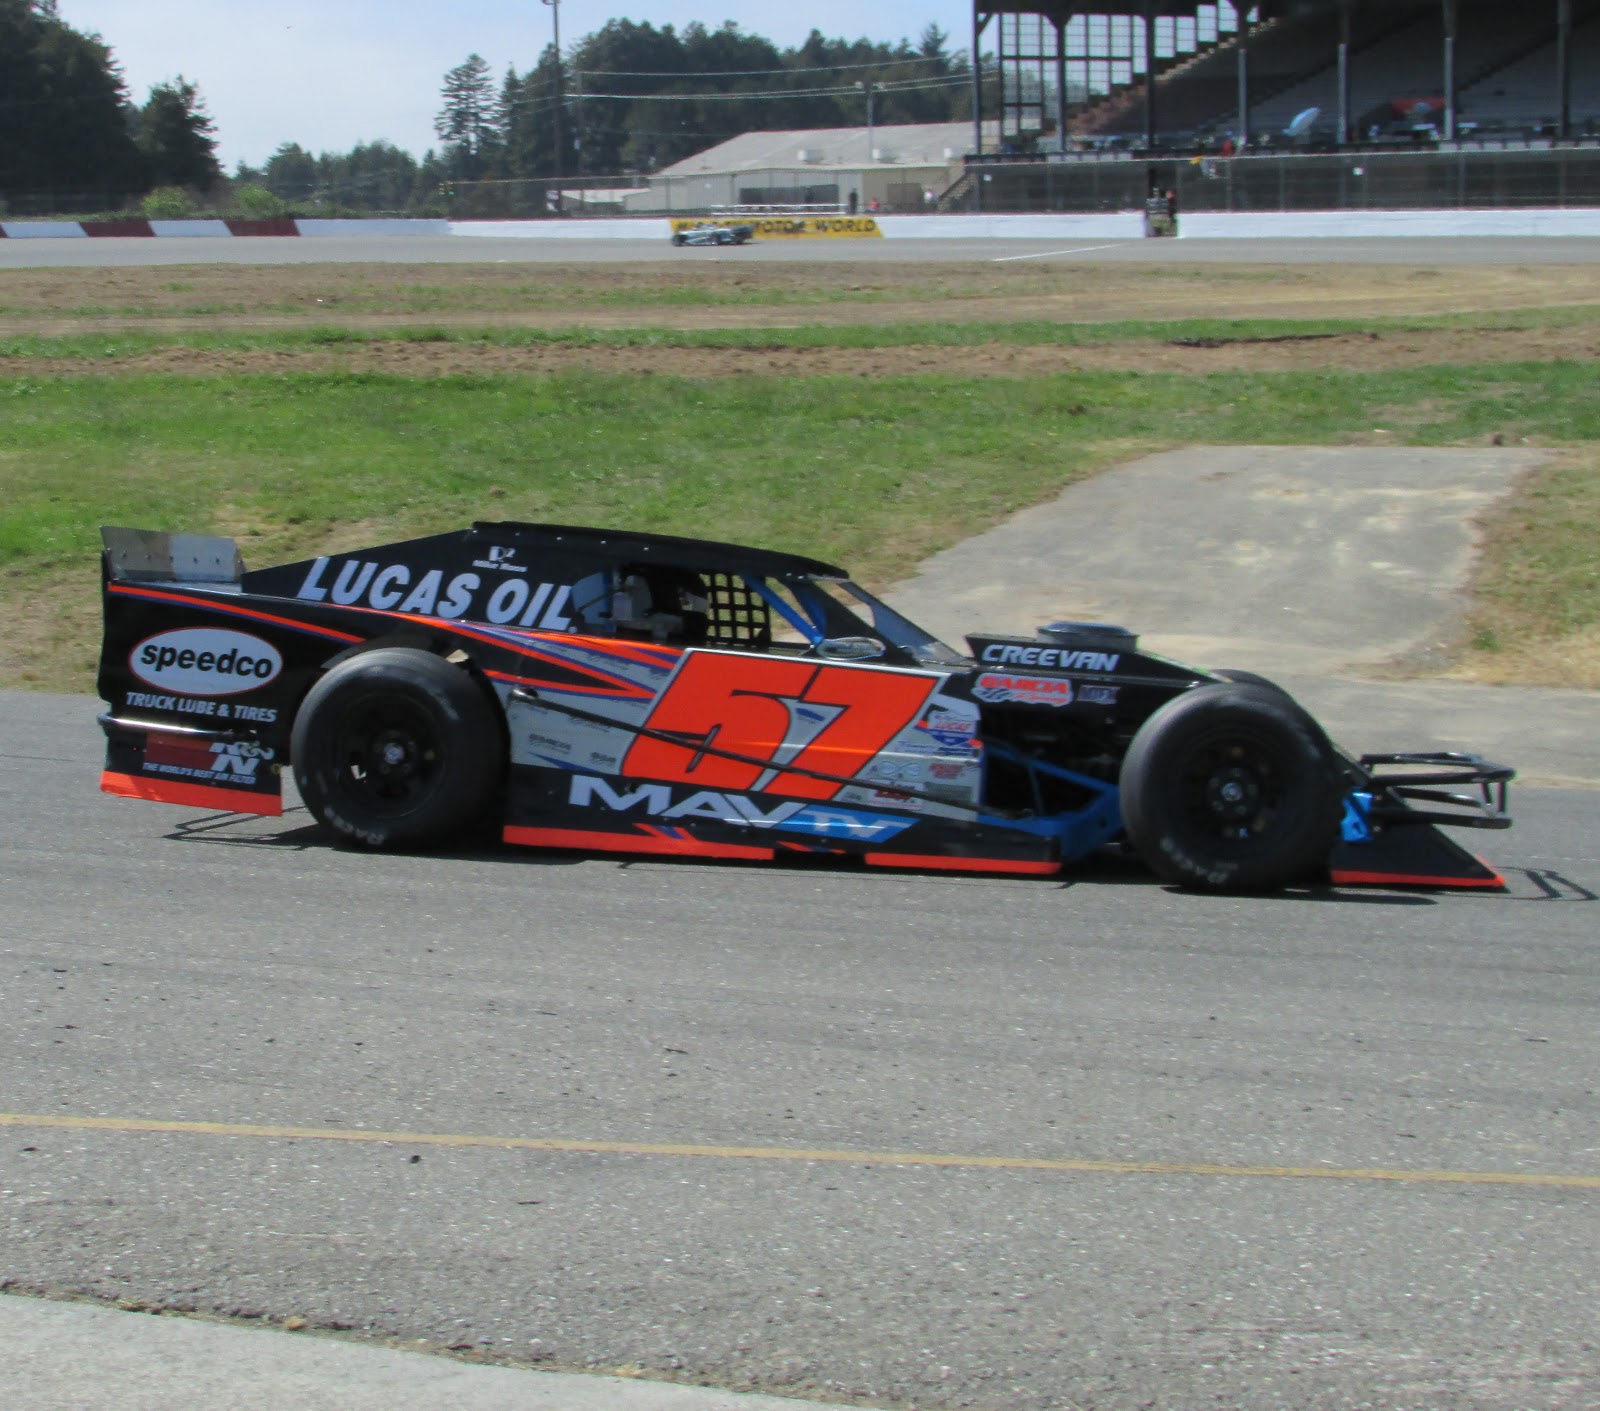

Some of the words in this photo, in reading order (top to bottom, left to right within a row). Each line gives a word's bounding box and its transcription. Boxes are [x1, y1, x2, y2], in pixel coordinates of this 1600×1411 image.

[297, 556, 481, 620] LUCAS
[486, 577, 572, 632] OIL
[140, 641, 274, 680] speedco
[981, 644, 1120, 672] CREEVAN
[126, 691, 175, 711] TRUCK
[176, 698, 217, 716] LUBE
[217, 703, 230, 718] &
[234, 704, 279, 723] TIRES
[621, 650, 938, 801] 57
